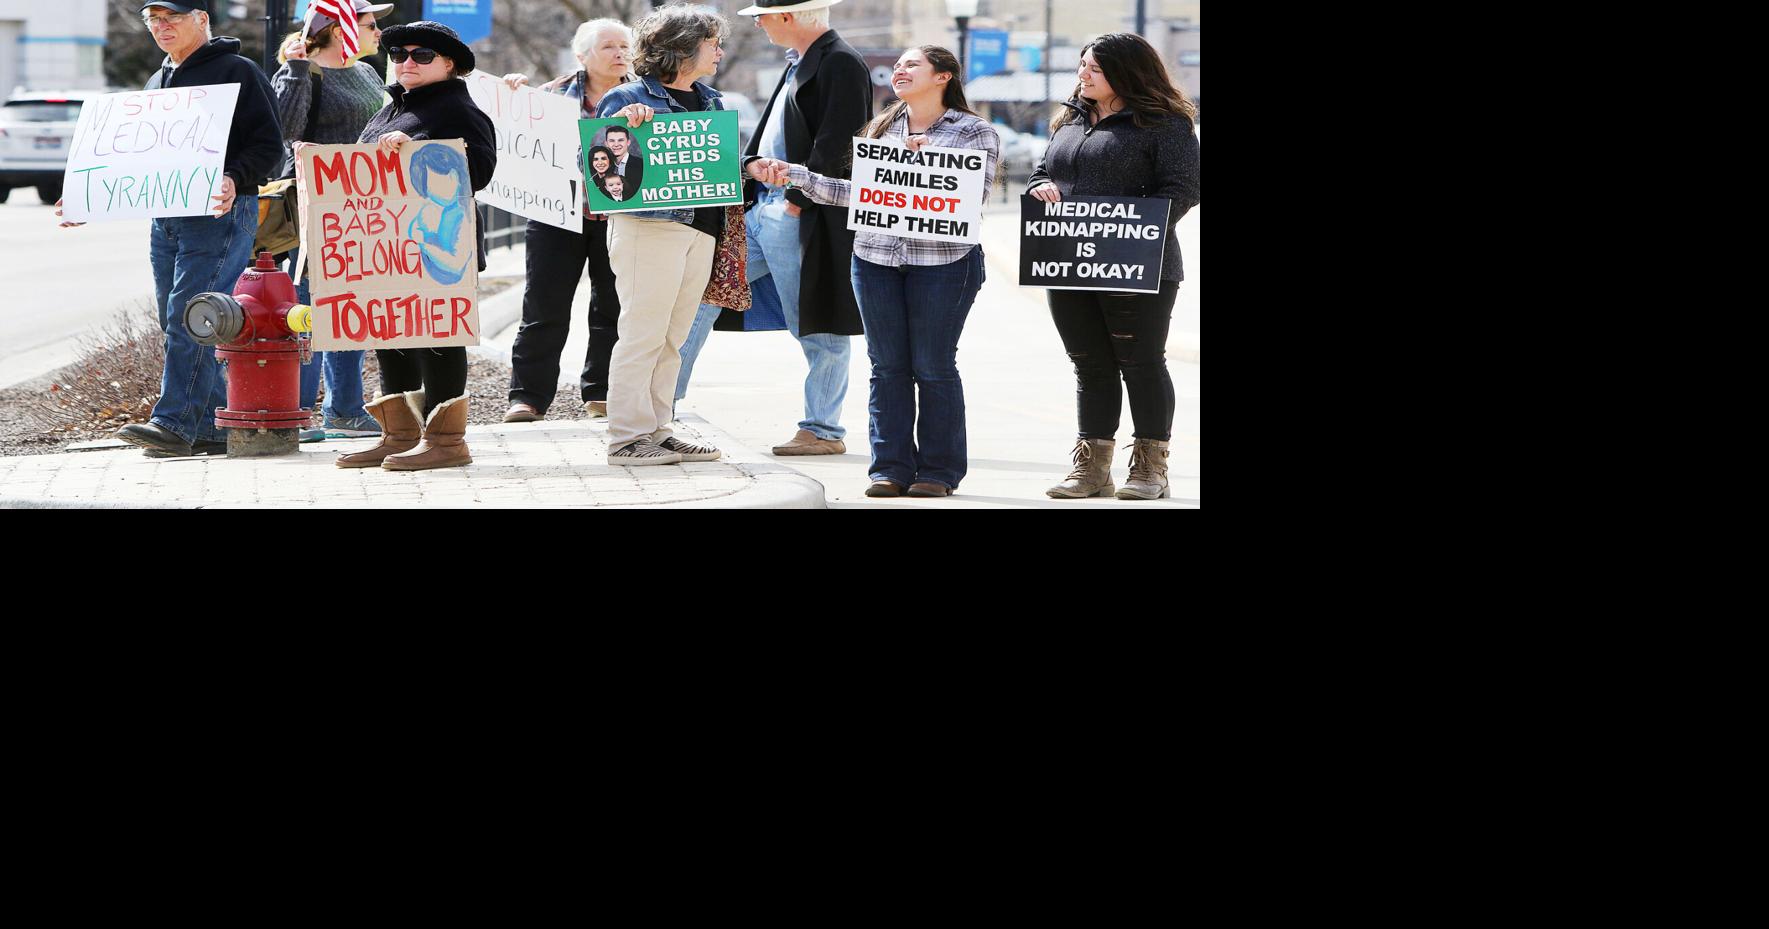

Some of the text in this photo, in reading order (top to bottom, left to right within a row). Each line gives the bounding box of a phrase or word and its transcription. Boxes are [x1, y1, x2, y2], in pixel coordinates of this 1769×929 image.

[123, 88, 207, 116] STOP
[478, 76, 544, 128] STOP
[73, 97, 219, 160] MEDICAL
[652, 118, 712, 135] BABY
[494, 128, 564, 169] DICAL
[647, 133, 720, 150] CYRUS
[649, 148, 721, 166] NEEDS
[856, 143, 982, 171] SEPARATING
[312, 149, 407, 196] MOM
[668, 167, 704, 182] HIS
[874, 167, 958, 191] FAMILES
[73, 165, 217, 215] TYRANNY
[343, 196, 384, 211] AND
[489, 178, 577, 225] napping!
[641, 182, 737, 201] MOTHER!
[860, 187, 961, 214] DOES NOT
[322, 204, 407, 244] BABY
[854, 209, 969, 237] HELP THEM
[1044, 201, 1142, 220] MEDICAL
[1025, 220, 1160, 240] KIDNAPPING
[321, 238, 423, 283] BELONG
[1076, 242, 1097, 258] IS
[1031, 261, 1145, 280] NOT OKAY!
[315, 292, 474, 342] TOGETHER
